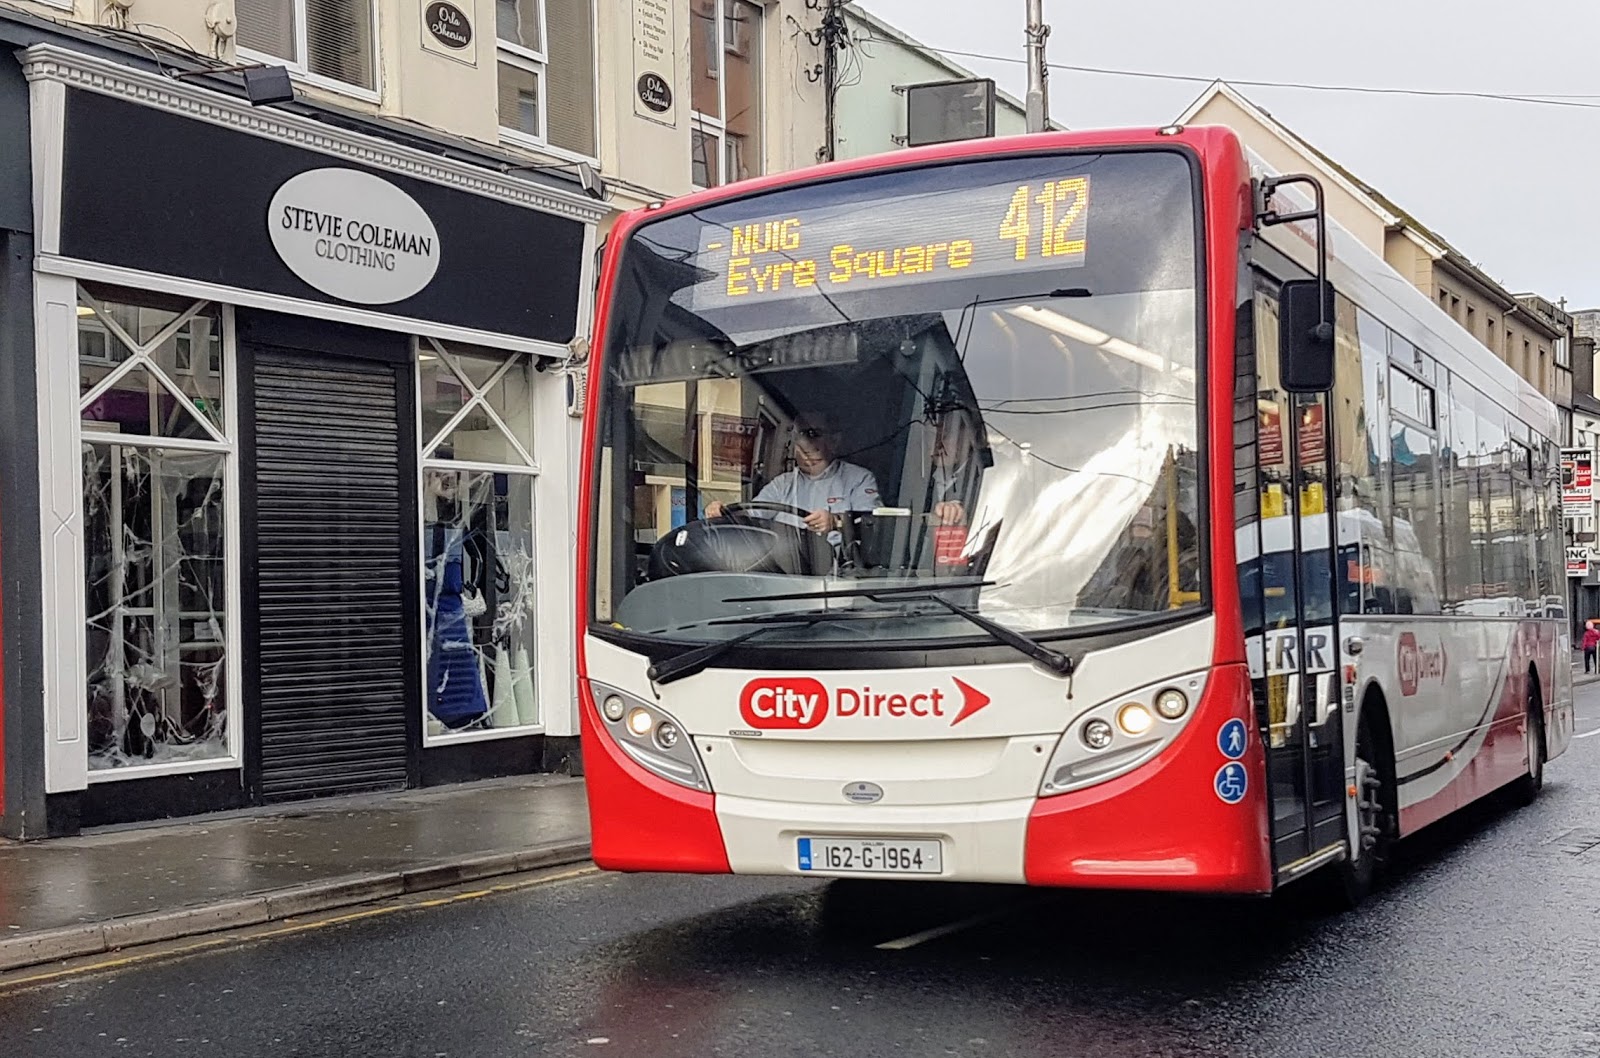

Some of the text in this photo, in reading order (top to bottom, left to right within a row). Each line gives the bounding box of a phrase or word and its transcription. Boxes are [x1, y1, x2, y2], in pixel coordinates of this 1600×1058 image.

[282, 206, 431, 256] STEVIE COLEMAN
[731, 219, 800, 256] NUIG
[999, 178, 1087, 260] 412
[315, 239, 396, 271] CLOTHING
[727, 240, 973, 296] Eyre Square
[750, 687, 944, 725] City Direct
[825, 846, 923, 870] 162-G-1964
